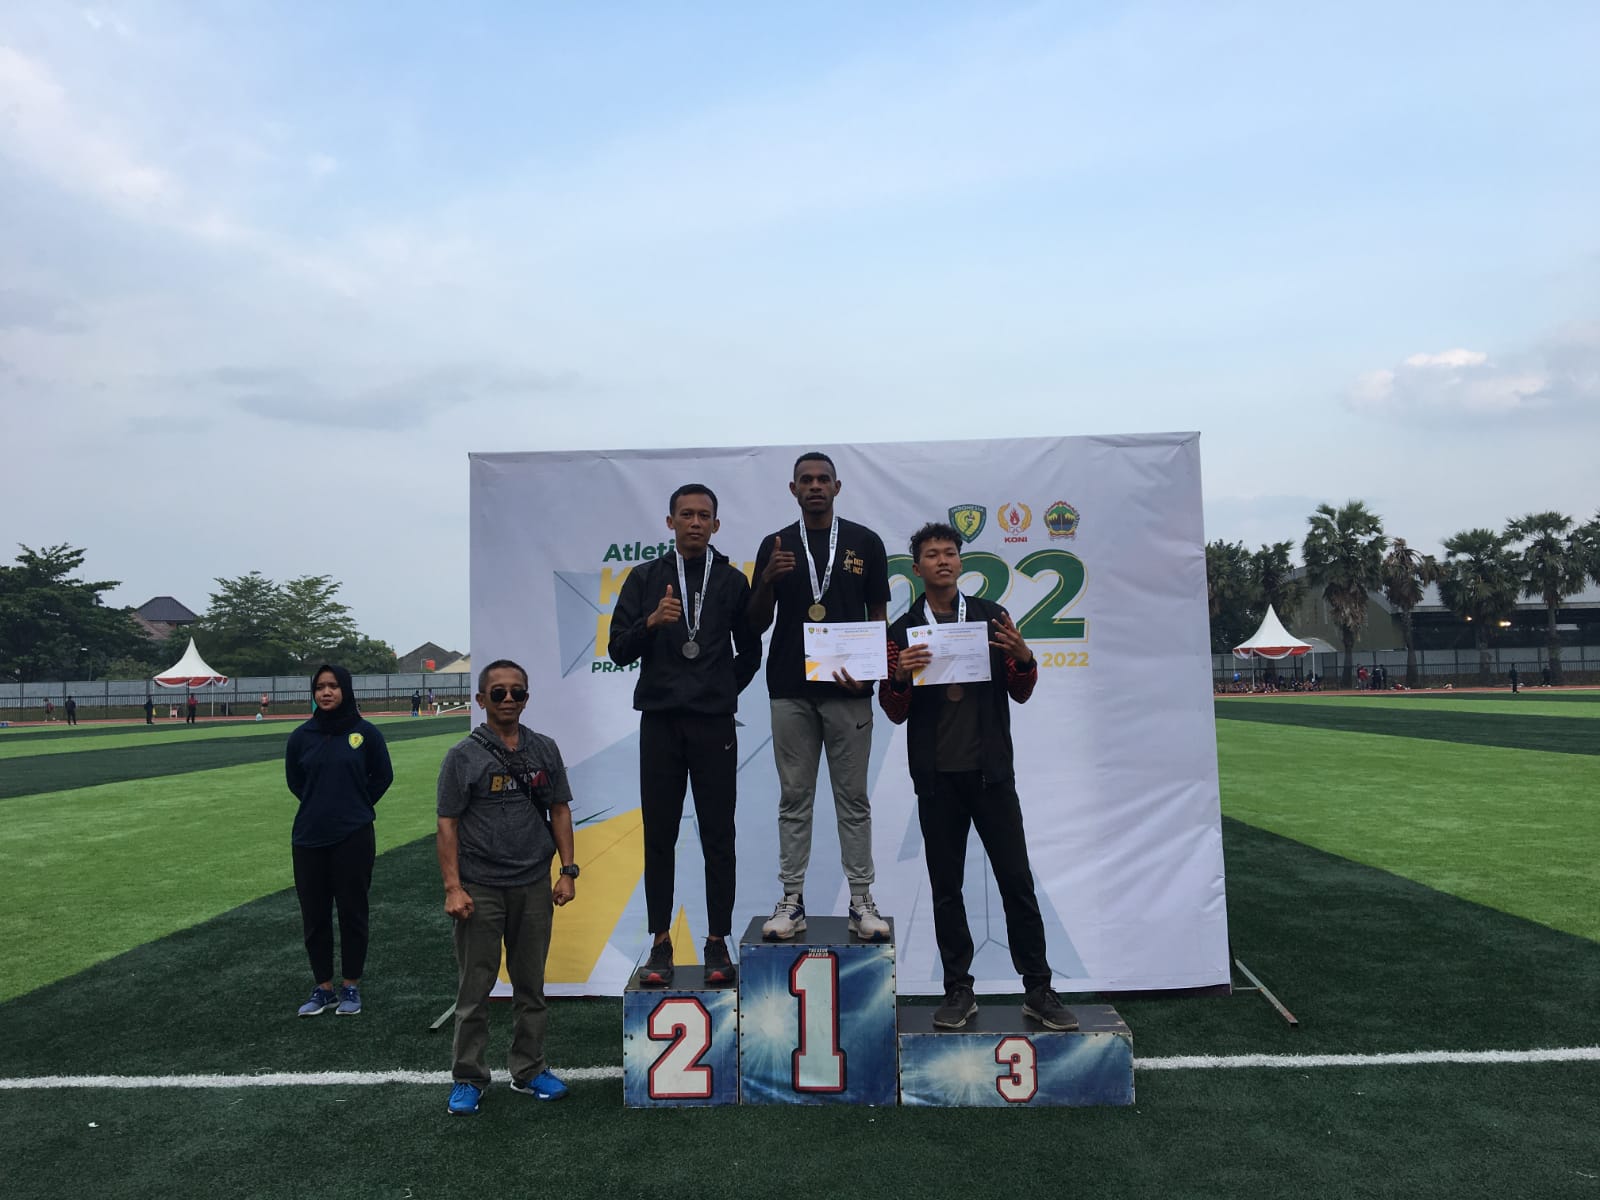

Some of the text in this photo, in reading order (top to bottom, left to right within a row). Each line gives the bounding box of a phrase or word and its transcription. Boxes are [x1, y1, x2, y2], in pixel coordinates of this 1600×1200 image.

[951, 504, 985, 513] INDONESIA
[602, 538, 677, 562] Atleti
[1004, 536, 1028, 544] KONI
[1041, 651, 1089, 668] 2022
[790, 952, 846, 1094] 1
[648, 997, 712, 1099] 2
[995, 1036, 1037, 1101] 3
